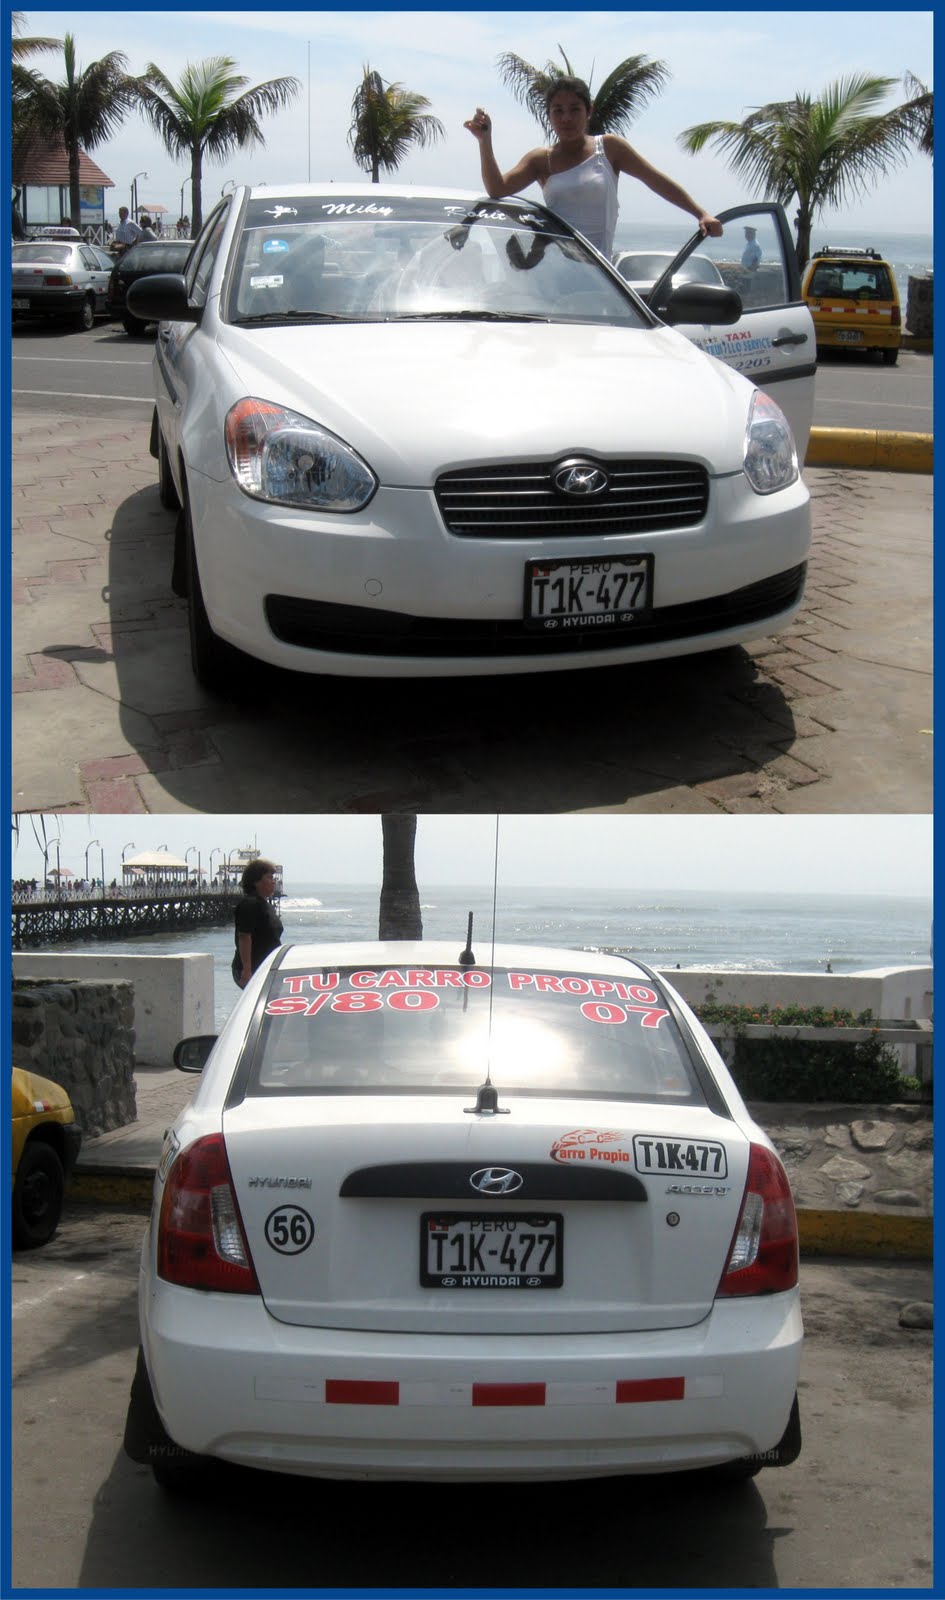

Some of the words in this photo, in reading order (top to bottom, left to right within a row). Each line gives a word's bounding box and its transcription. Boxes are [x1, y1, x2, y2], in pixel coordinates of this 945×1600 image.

[321, 202, 394, 217] Miky
[725, 331, 752, 341] TAXI
[743, 337, 771, 351] SERVICE
[570, 561, 612, 575] PERU
[533, 571, 645, 615] T1K-477
[563, 614, 615, 627] HYUNDAI
[283, 972, 339, 994] TU
[348, 970, 492, 990] CARRO
[507, 972, 658, 1004] PROPIO
[264, 989, 440, 1016] S/80
[580, 1000, 671, 1029] 07
[590, 1148, 630, 1163] Propio
[248, 1176, 313, 1189] HYUNDAI
[273, 1214, 307, 1246] 56
[470, 1220, 517, 1232] PERU
[431, 1233, 555, 1272] T1K-477
[462, 1276, 521, 1286] HYUNDAI
